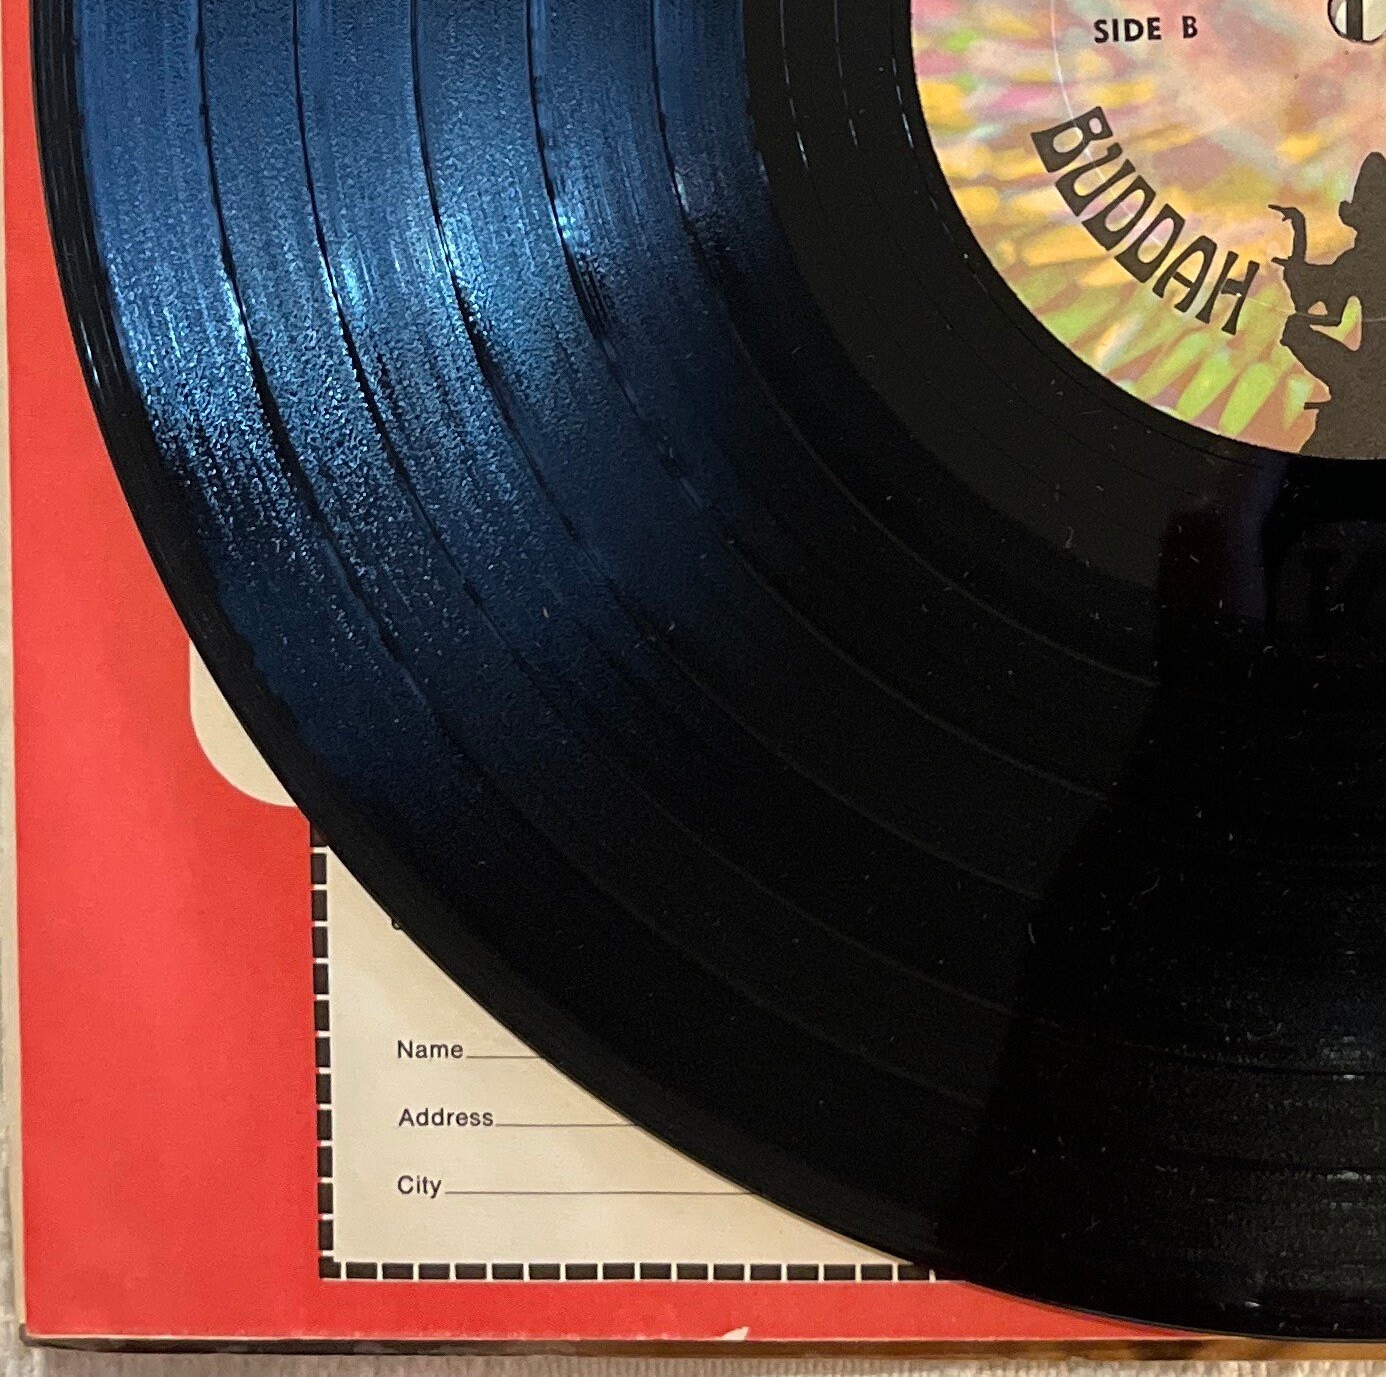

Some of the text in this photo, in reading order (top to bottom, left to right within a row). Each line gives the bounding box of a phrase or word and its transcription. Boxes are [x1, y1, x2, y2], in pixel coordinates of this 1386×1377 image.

[1094, 15, 1198, 43] SIDE B
[1031, 105, 1260, 336] BUDDAH
[397, 1039, 464, 1059] Name
[398, 1107, 494, 1127] Address
[397, 1174, 442, 1199] City
